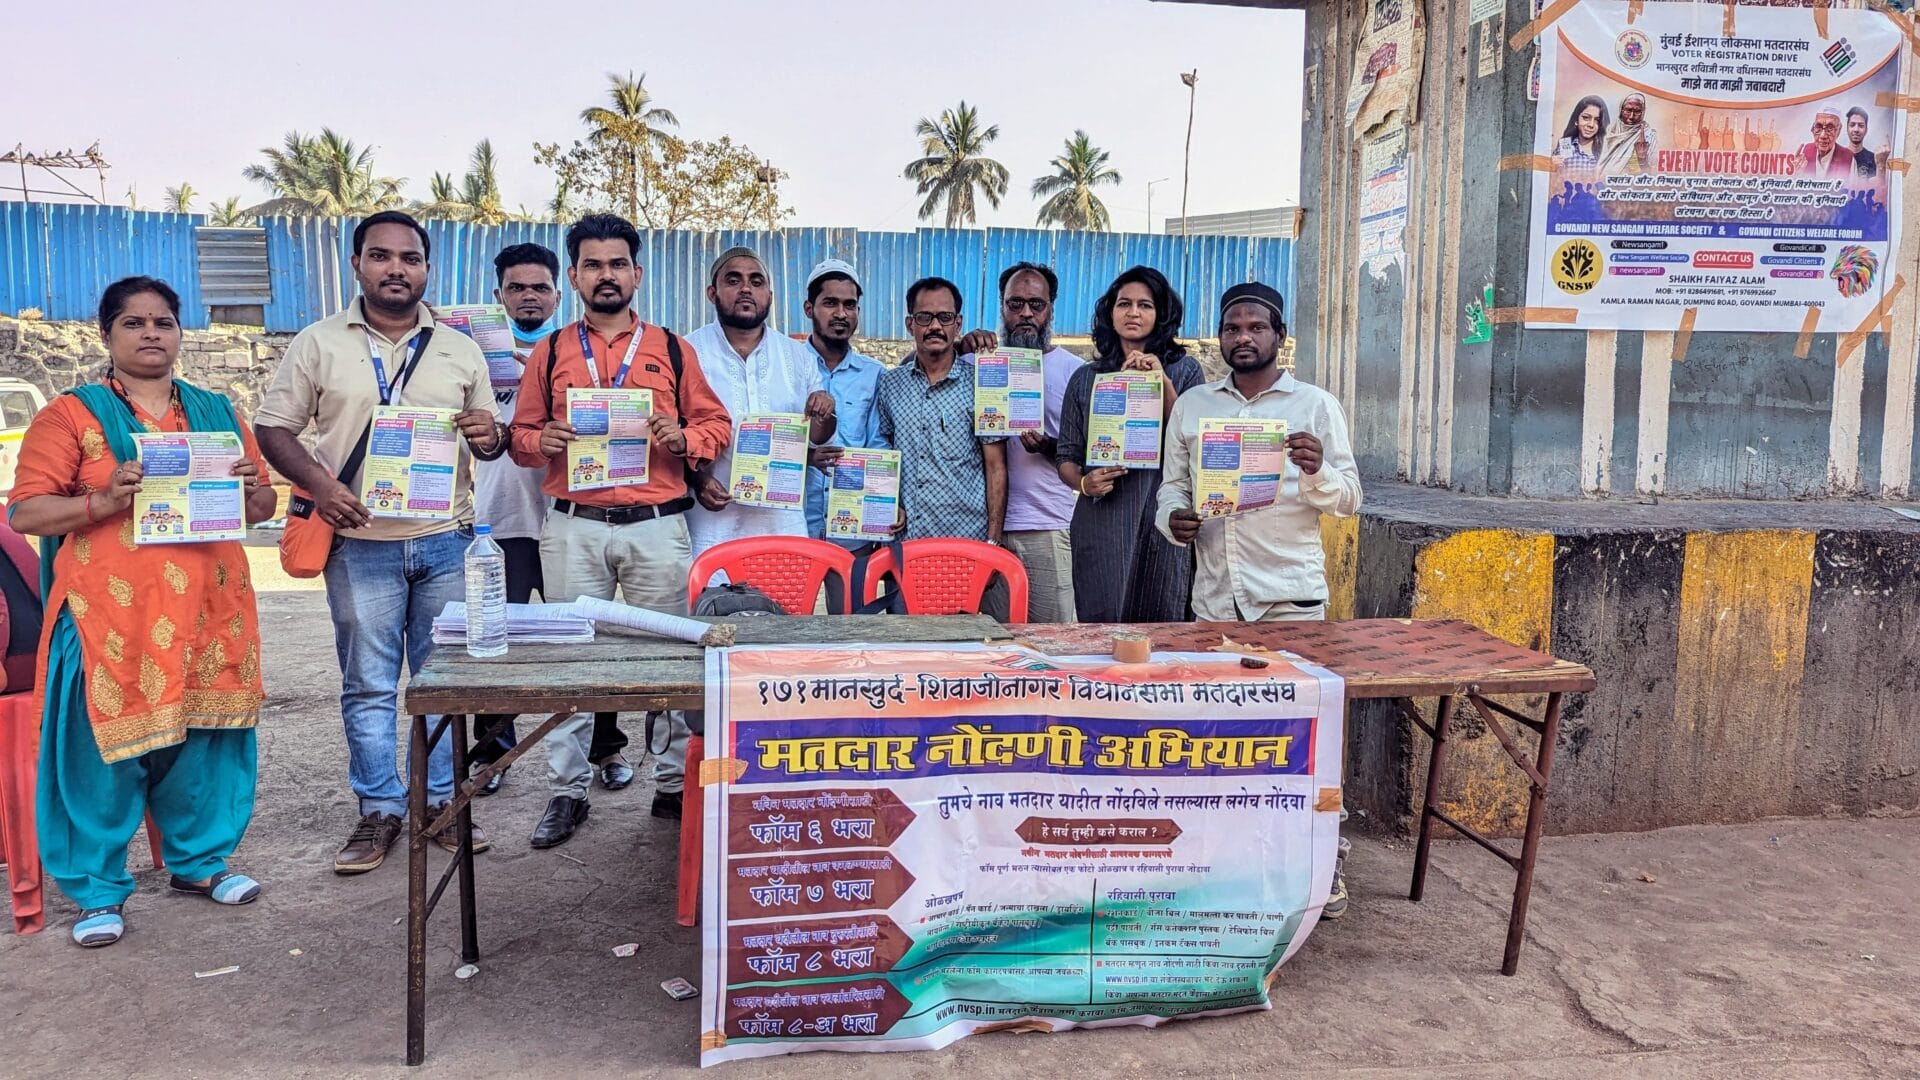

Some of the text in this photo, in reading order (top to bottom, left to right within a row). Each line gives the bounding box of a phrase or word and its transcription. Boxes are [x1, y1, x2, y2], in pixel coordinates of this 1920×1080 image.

[1660, 34, 1681, 49] मुंबई
[1721, 35, 1760, 49] लोकसभा
[1764, 38, 1810, 51] मतदारसंघ
[1672, 50, 1798, 62] VOTER REGISTRATION DRIVE
[1719, 66, 1734, 74] नगर
[1776, 68, 1812, 77] मतदारसंघ
[1681, 76, 1785, 92] माझे मत माझी जबाबदारी
[1658, 150, 1794, 176] EVERY VOTE COUNTS
[1607, 176, 1632, 184] स्वतंत्र
[1636, 175, 1653, 185] और
[1712, 177, 1742, 188] लोकतंत्र
[1746, 178, 1756, 188] की
[1760, 178, 1792, 190] बुनियादी
[1599, 189, 1616, 200] और
[1620, 190, 1652, 200] लोकतंत्र
[1656, 190, 1676, 201] हमारे
[1716, 192, 1732, 202] और
[1774, 195, 1798, 204] शासन
[1802, 194, 1813, 204] की
[1709, 208, 1720, 217] का
[1723, 209, 1736, 217] एक
[1555, 223, 1862, 238] GOVANDI NEW SANGAM WELFARE SOCIETY & GOVANDI CITIZENS WELFARE FORUM
[1696, 254, 1752, 263] CONTACT US
[1558, 280, 1595, 290] GNSW
[1669, 275, 1766, 285] SHAIKH FAIYAZ ALAM
[1655, 298, 1682, 306] NAGAR,
[1068, 676, 1184, 702] विधानसभा
[1190, 678, 1296, 706] मतदारसंघ
[756, 724, 1294, 774] मतदार नोंदणी अभियान
[938, 786, 1306, 820] तुमचे नाव मतदार यादीत नोंदविले नसल्यास लगेच नोंदवा
[808, 820, 824, 844] ६
[832, 818, 876, 840] भरा
[1042, 822, 1158, 842] हे सर्व तुम्ही कसे कराल ?
[806, 885, 824, 902] ७
[832, 879, 874, 902] भरा
[1107, 888, 1176, 904] रहिवासी पुरावा
[924, 890, 964, 909] ओळखपत्र
[805, 952, 822, 971] ८
[832, 946, 874, 970] भरा
[935, 1002, 995, 1022] www.nvsp.in
[788, 1017, 837, 1035] ८-अ
[841, 1013, 878, 1034] भरा
